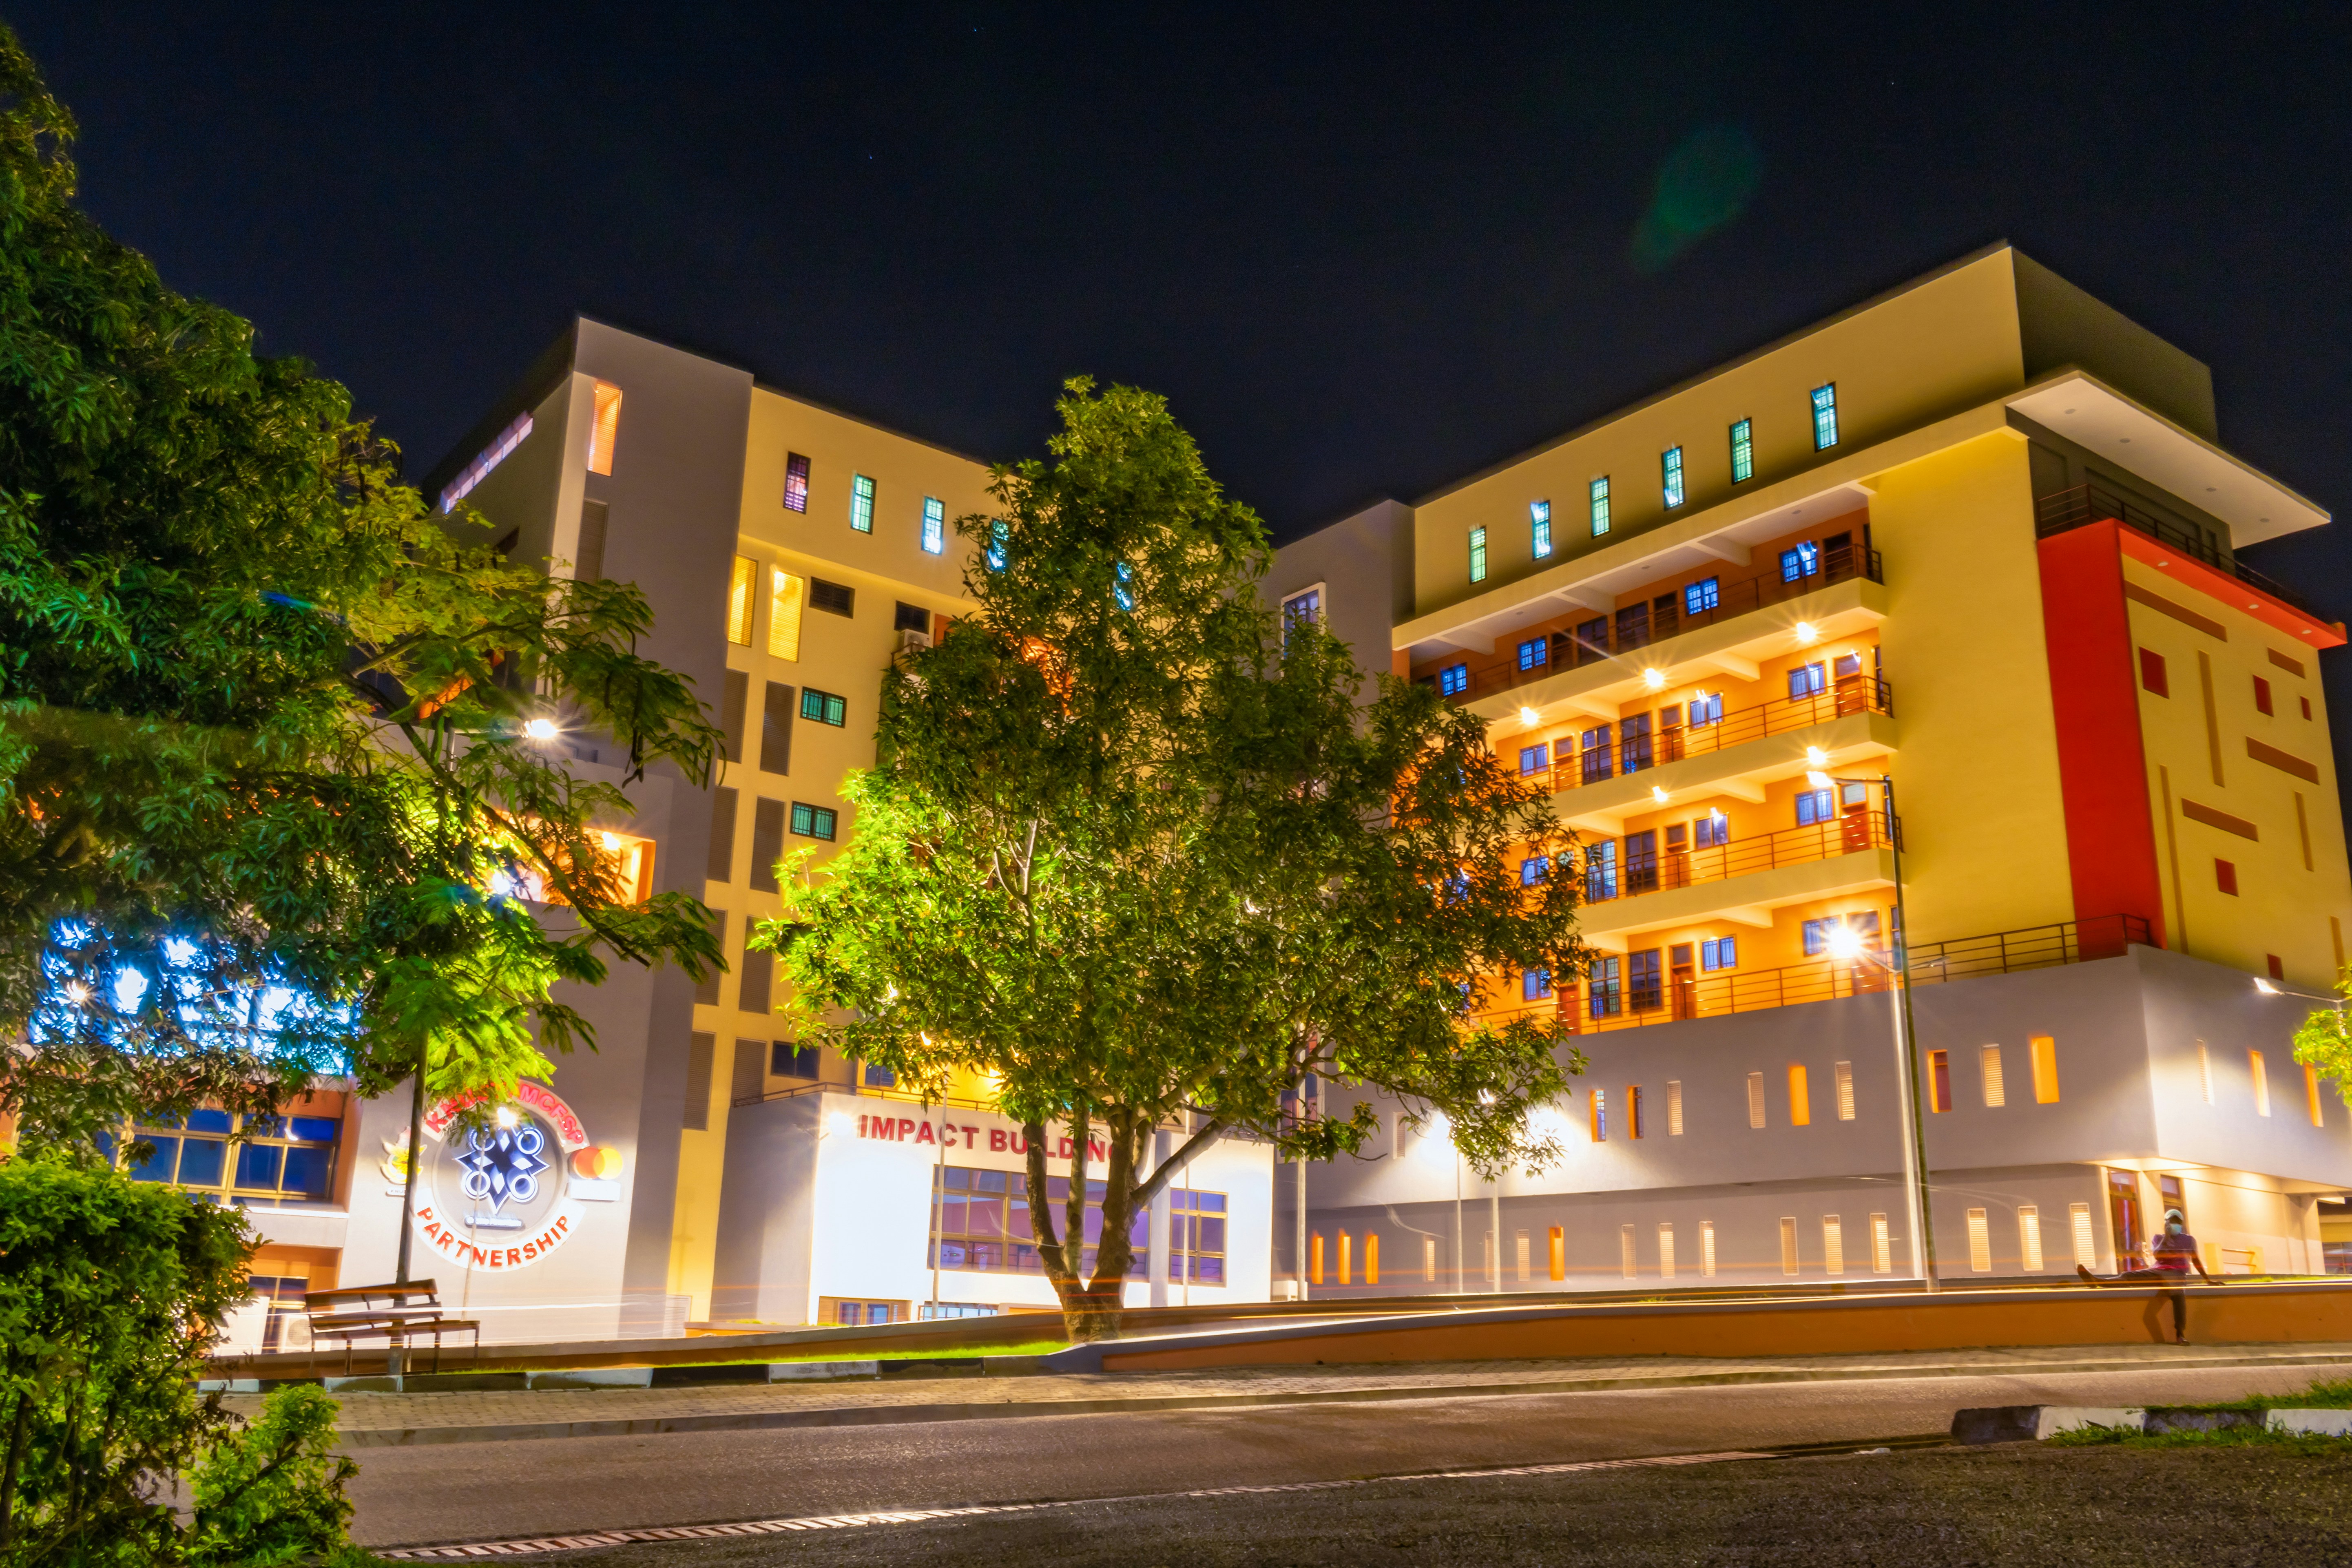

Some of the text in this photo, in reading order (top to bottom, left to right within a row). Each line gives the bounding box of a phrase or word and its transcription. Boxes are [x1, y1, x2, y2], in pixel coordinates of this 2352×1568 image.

[860, 1115, 1113, 1162] IMPACT BULDN
[417, 1207, 568, 1267] PARTNERSHIP
